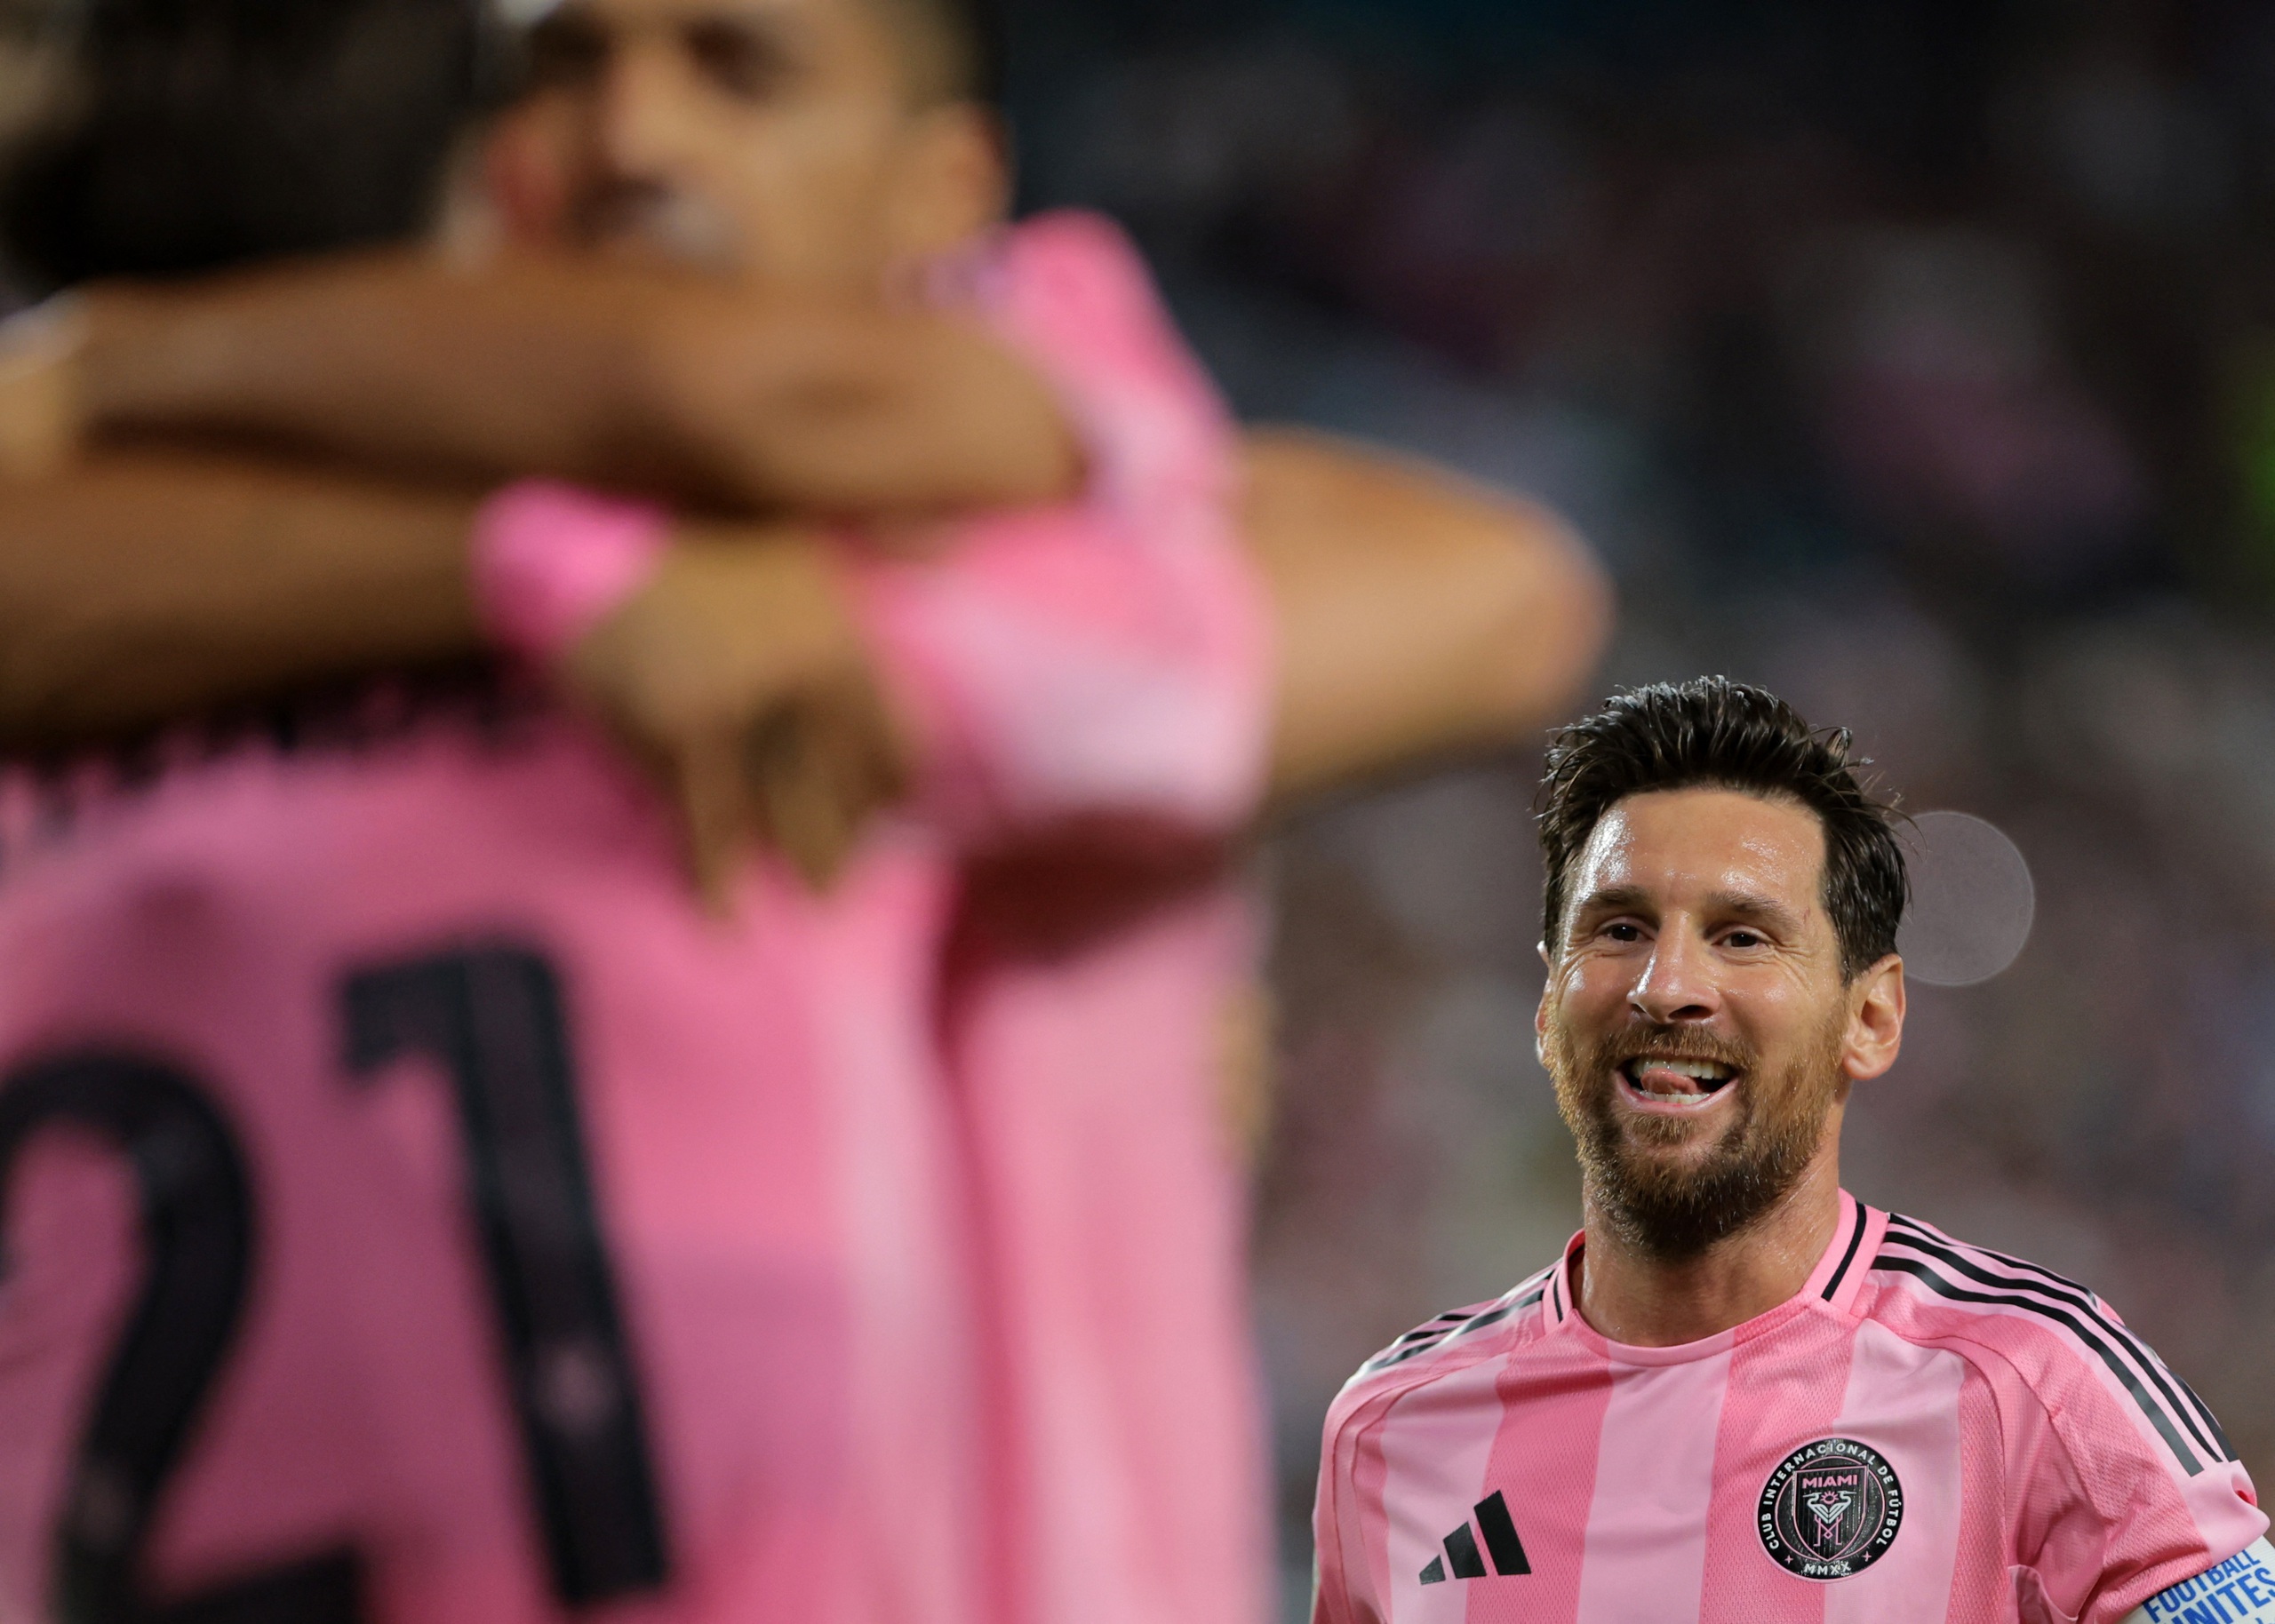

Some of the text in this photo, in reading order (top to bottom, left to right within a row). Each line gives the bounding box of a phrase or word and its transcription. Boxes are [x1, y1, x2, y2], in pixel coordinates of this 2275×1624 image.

[0, 937, 670, 1624] 21
[1761, 1443, 1902, 1549] CLUB INTERNACIONAL DE FÚTBOL
[1802, 1475, 1857, 1489] MIAMI
[1804, 1562, 1852, 1575] MMXX
[2142, 1549, 2261, 1623] FOOTBALL
[2171, 1567, 2275, 1624] NITES
